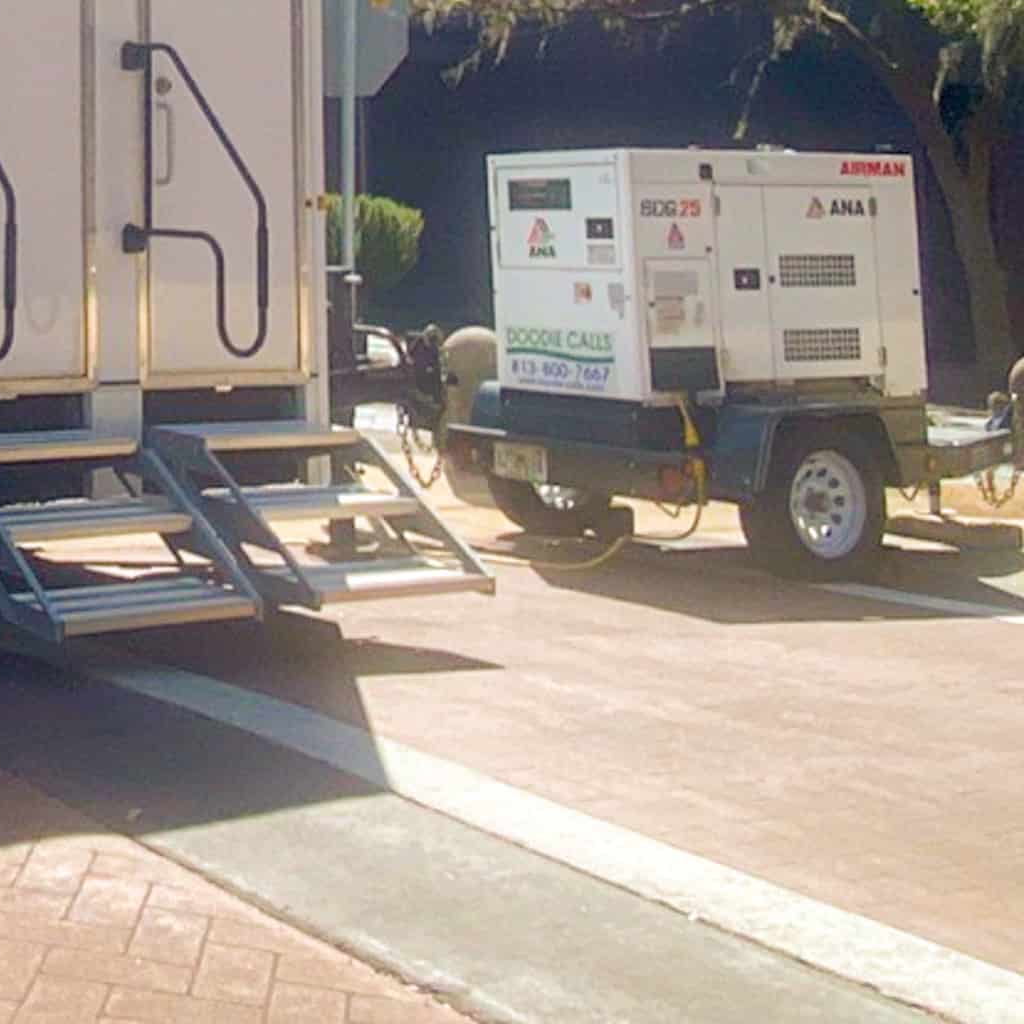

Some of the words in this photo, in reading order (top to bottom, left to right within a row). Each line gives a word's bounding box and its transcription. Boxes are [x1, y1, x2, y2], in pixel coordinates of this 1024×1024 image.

[840, 161, 905, 177] AIRMAN
[830, 199, 864, 217] ANA
[528, 245, 556, 258] ANA
